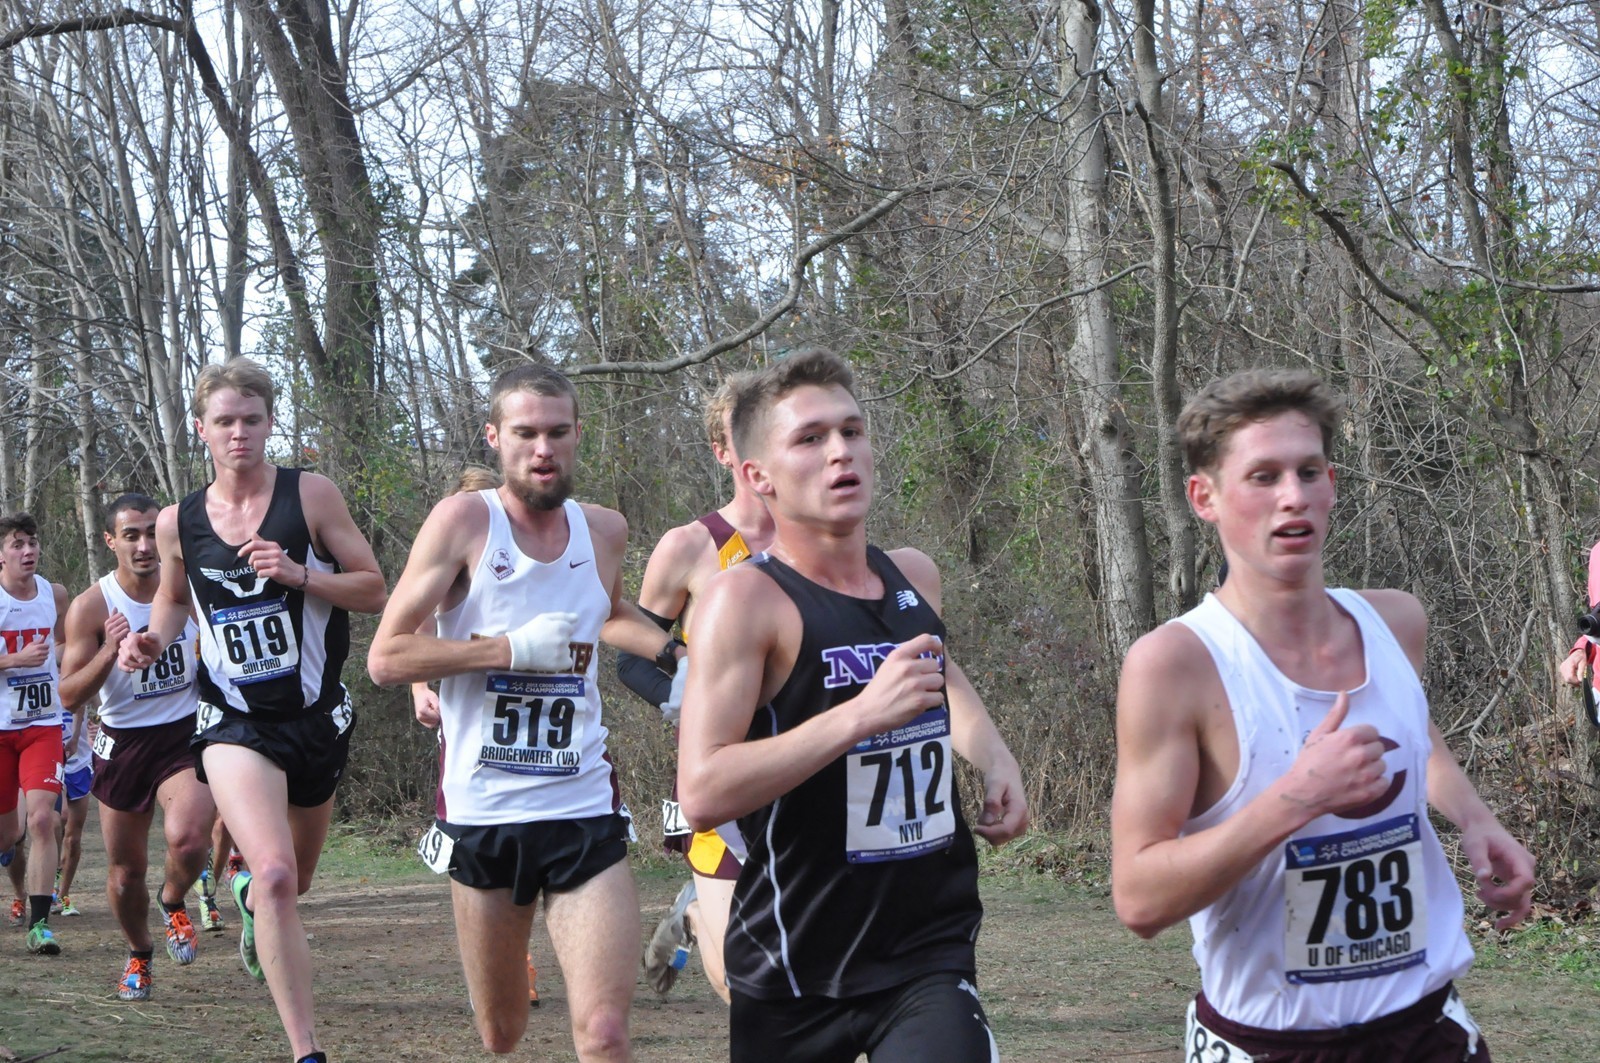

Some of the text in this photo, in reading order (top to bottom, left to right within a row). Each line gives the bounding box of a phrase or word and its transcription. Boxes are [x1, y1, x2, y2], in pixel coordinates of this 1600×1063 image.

[223, 615, 289, 665] 619
[242, 657, 281, 675] GUILFORD
[13, 682, 52, 711] 790
[142, 683, 148, 692] U
[149, 681, 157, 691] OF
[159, 675, 185, 689] CHICAGO
[492, 694, 576, 750] 519
[891, 724, 947, 744] CHAMPIONSHIPS
[904, 725, 921, 734] CROSS
[921, 719, 946, 730] COUNTRY
[480, 745, 580, 768] BRIDGEWATER (VA)
[860, 740, 946, 827] 712
[899, 821, 923, 844] NYU
[1301, 848, 1414, 945] 783
[1308, 947, 1319, 967] U
[1325, 945, 1344, 966] OF
[1349, 931, 1411, 964] CHICAGO
